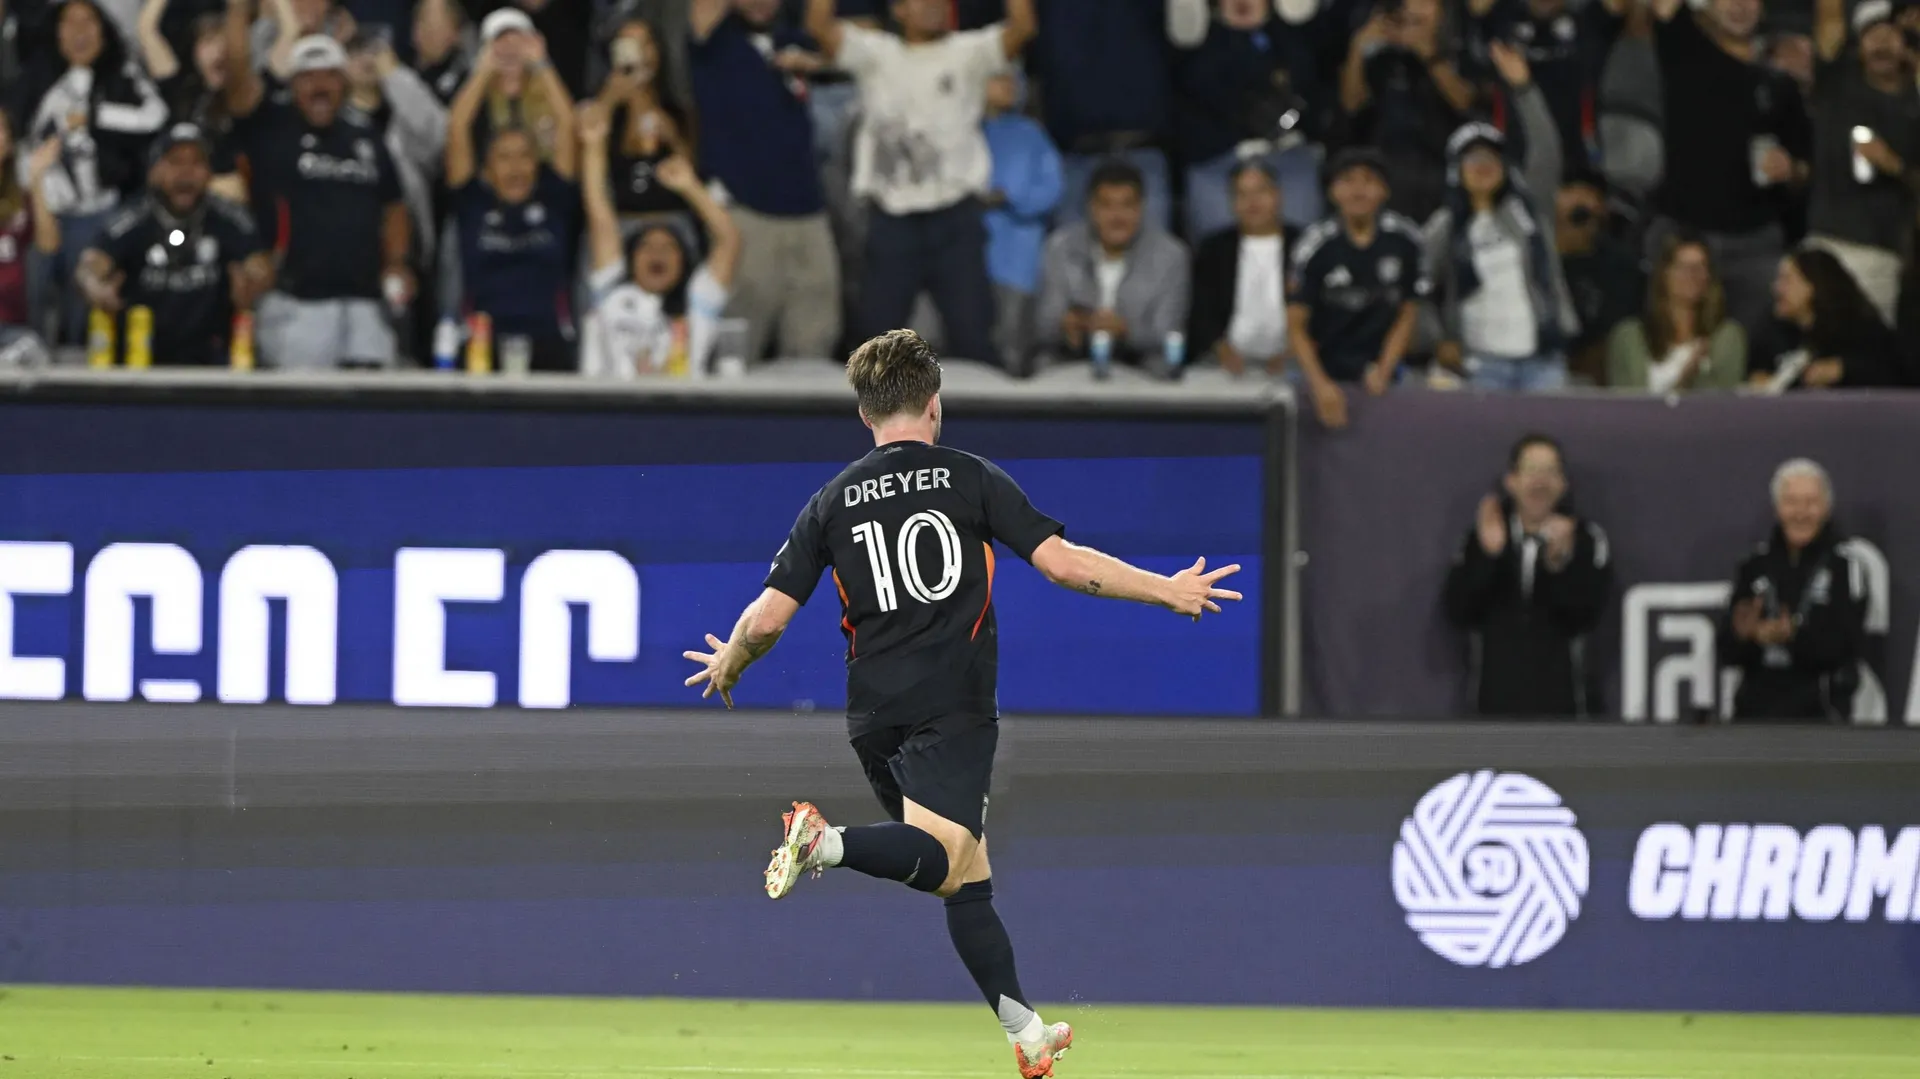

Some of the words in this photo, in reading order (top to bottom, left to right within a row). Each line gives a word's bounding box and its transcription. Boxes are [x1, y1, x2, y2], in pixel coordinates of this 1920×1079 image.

[844, 467, 951, 507] DREYER
[851, 509, 963, 612] 10
[1629, 823, 1920, 921] CHROM
